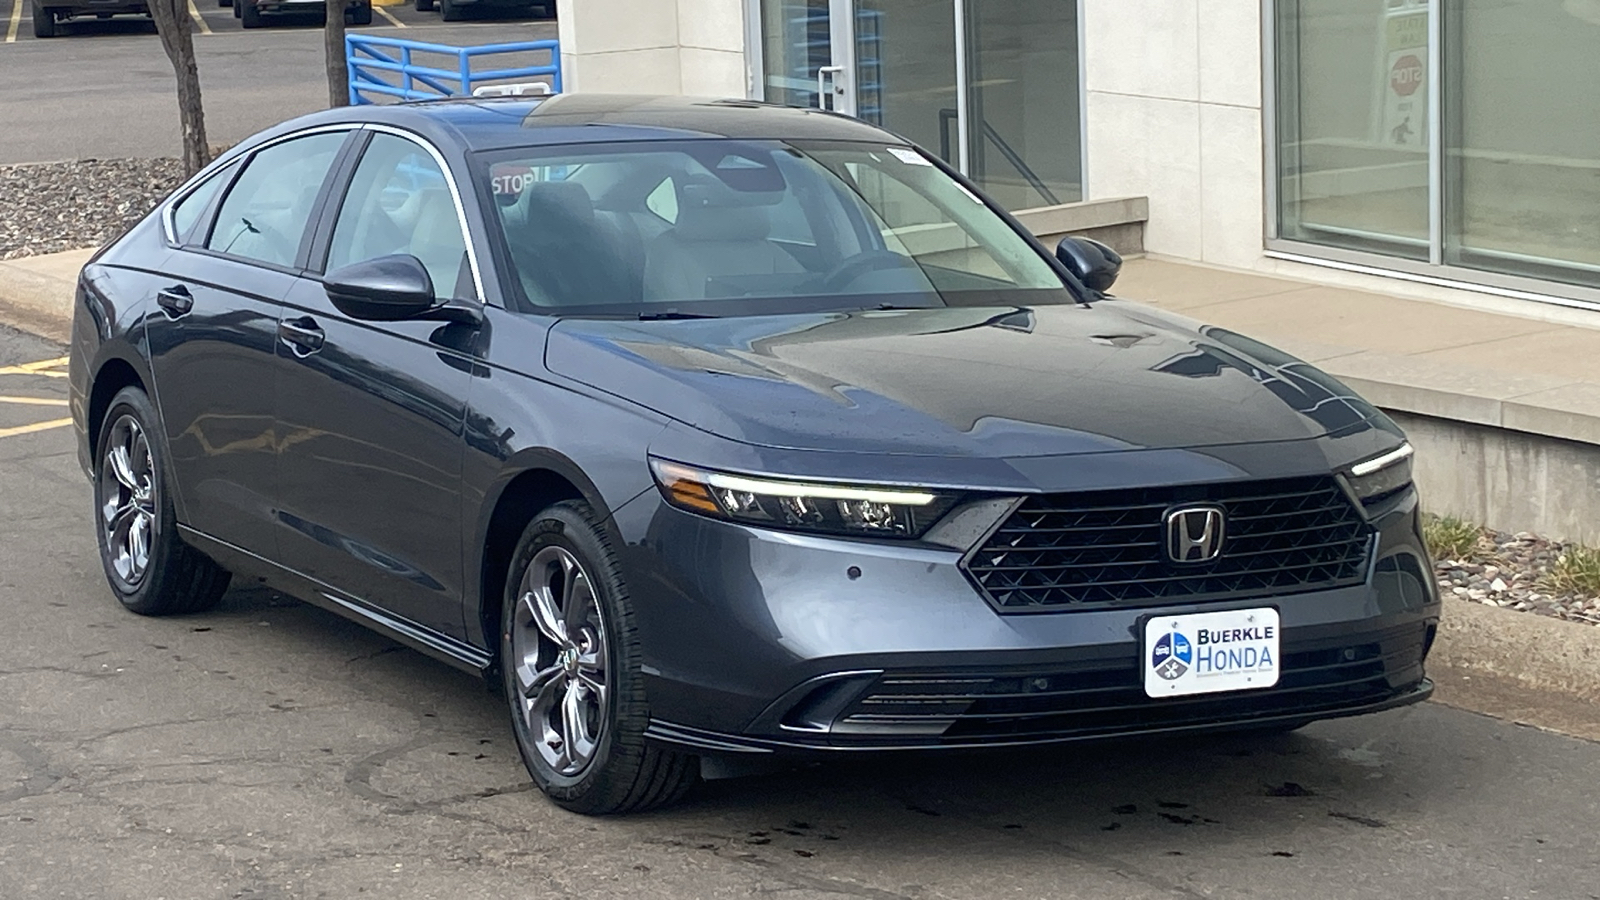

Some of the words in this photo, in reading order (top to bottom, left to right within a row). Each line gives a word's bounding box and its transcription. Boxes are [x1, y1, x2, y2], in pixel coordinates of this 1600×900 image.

[491, 172, 534, 194] STOP
[1197, 626, 1274, 645] BUERKLE
[1196, 645, 1273, 673] HONDA
